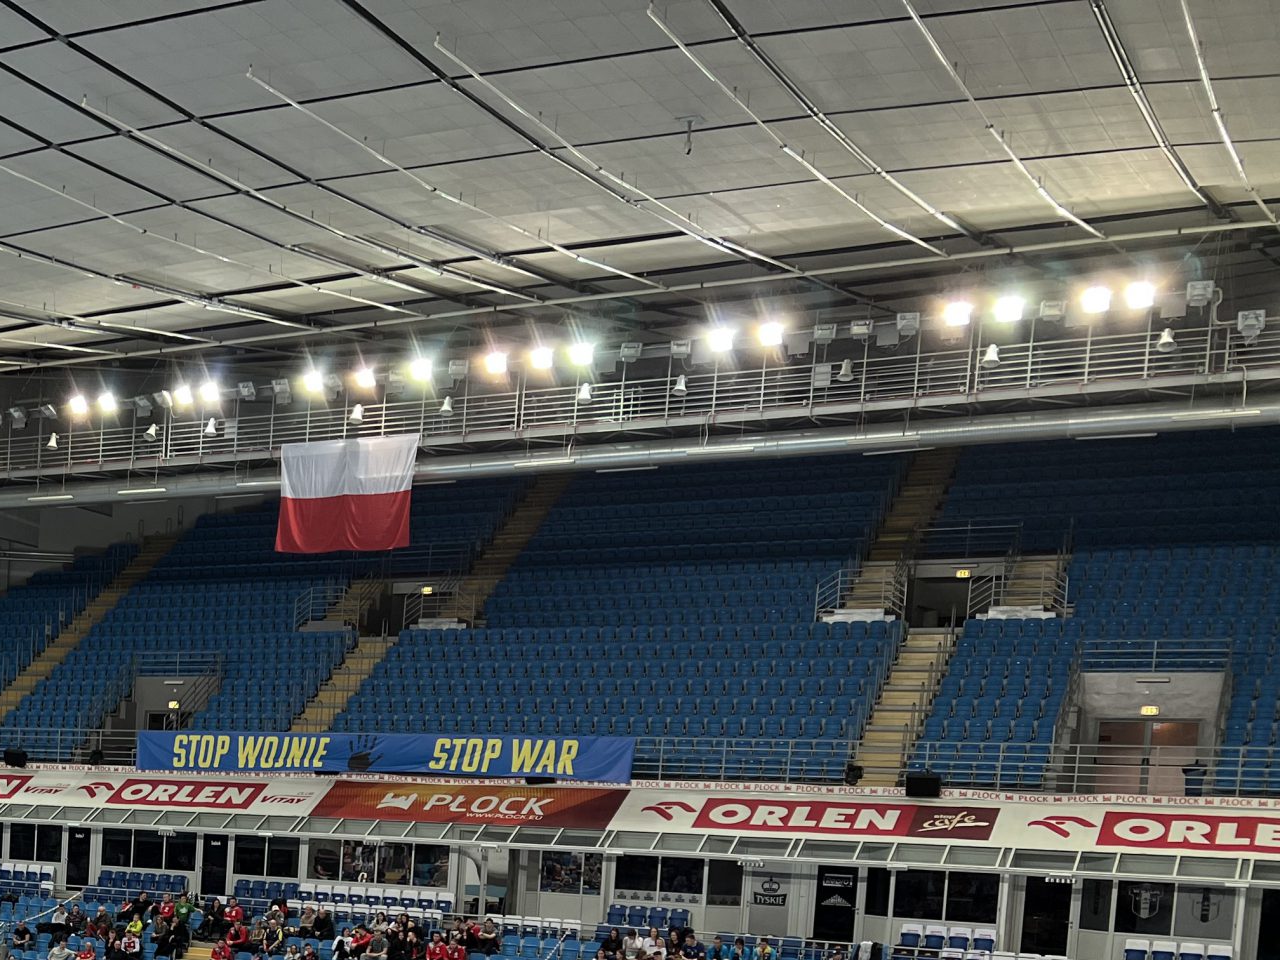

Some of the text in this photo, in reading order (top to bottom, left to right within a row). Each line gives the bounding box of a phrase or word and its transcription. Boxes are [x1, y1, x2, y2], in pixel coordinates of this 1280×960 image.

[173, 734, 330, 769] STOP WOJNIE
[428, 738, 579, 775] STOP WAR
[23, 786, 63, 795] VITAY
[120, 783, 255, 804] ORLEN
[796, 785, 822, 793] PŁOCK
[882, 788, 905, 796] PŁOC
[261, 795, 305, 804] VITAY
[972, 791, 1000, 799] PŁOCK
[1018, 795, 1048, 803] PŁOCK
[1067, 795, 1098, 803] PŁOCK
[1116, 795, 1147, 804] PŁOCK
[423, 794, 555, 816] PŁOCK
[1168, 796, 1200, 805] PŁOCK
[1220, 798, 1253, 807] PŁOCK
[466, 812, 543, 821] WWW.PLOCK.EU
[708, 803, 902, 831] ORLEN
[755, 895, 785, 905] TYSKIE
